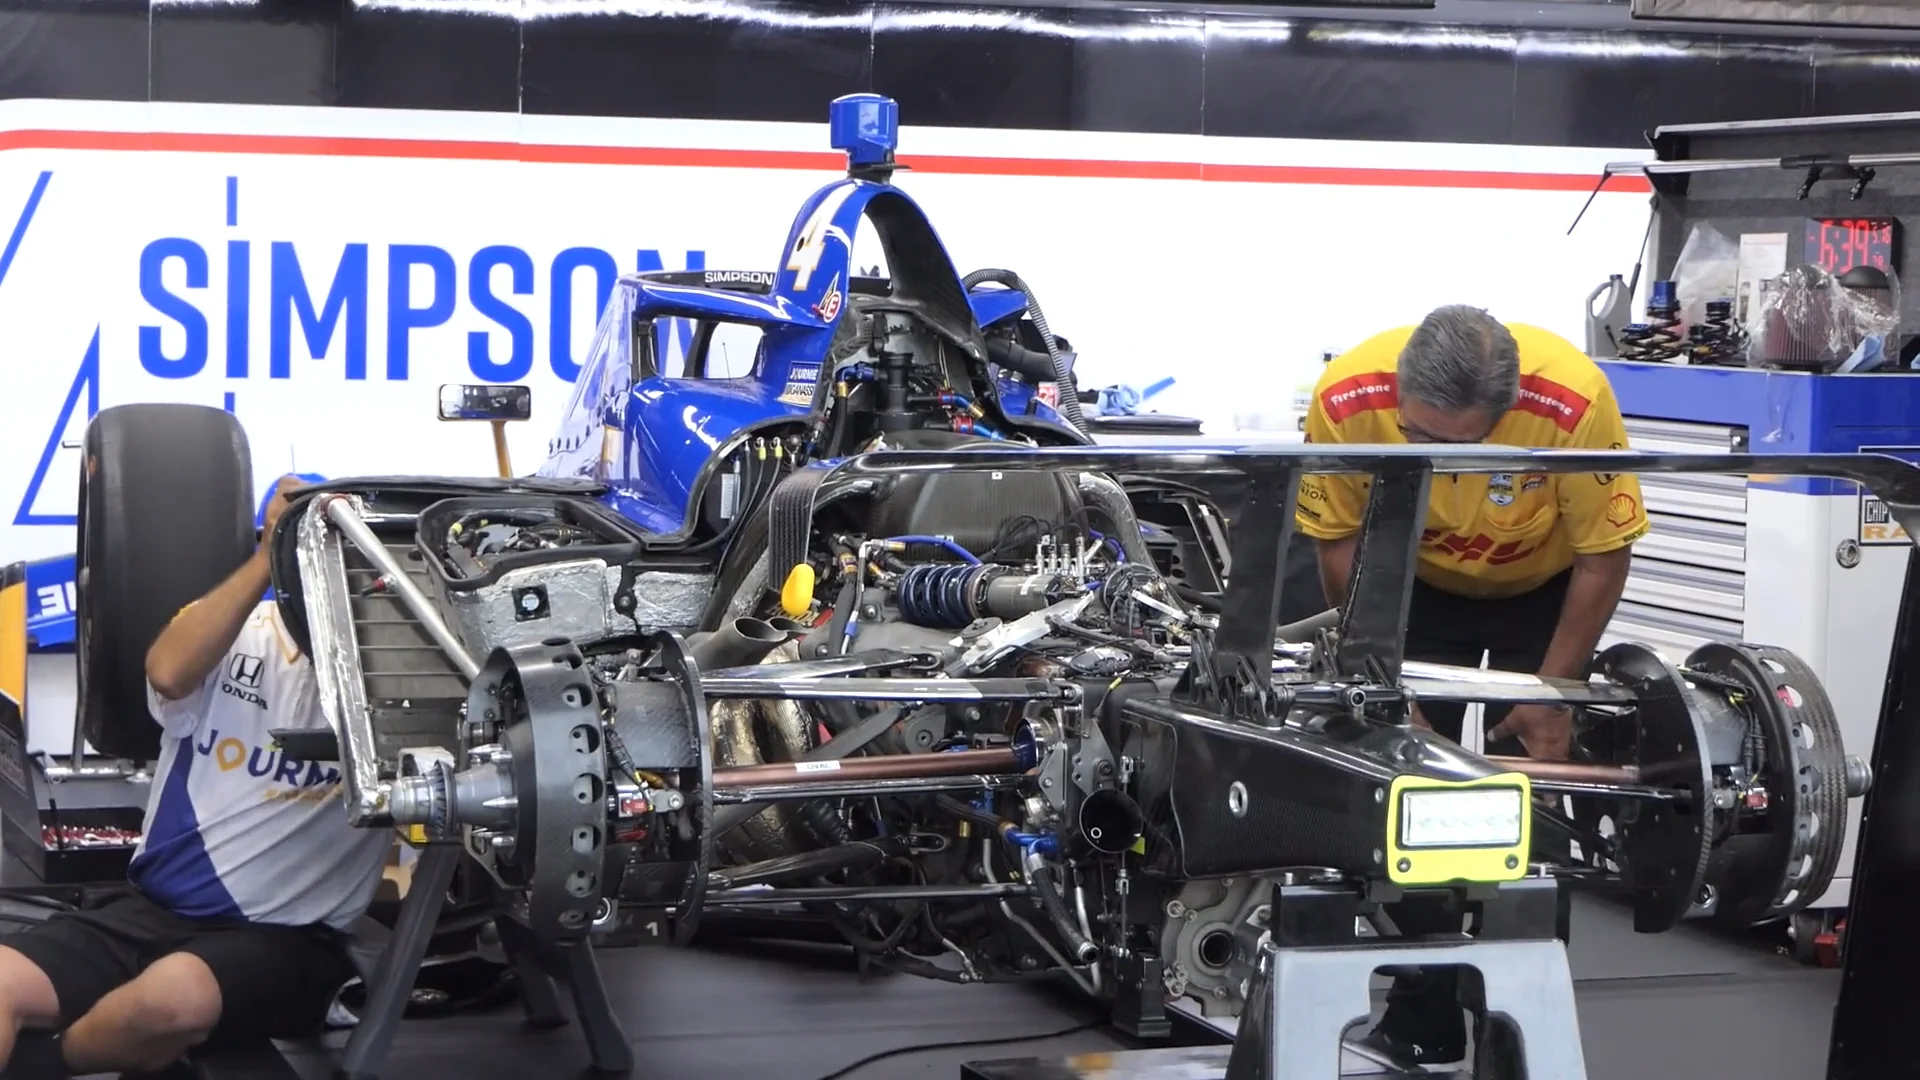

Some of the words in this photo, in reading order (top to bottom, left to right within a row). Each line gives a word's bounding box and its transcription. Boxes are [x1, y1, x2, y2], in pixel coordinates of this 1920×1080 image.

[705, 271, 773, 285] SIMPSON
[1331, 383, 1391, 405] Firestone
[1865, 501, 1889, 522] CHIP
[221, 681, 268, 711] ONDA
[645, 921, 658, 937] 1
